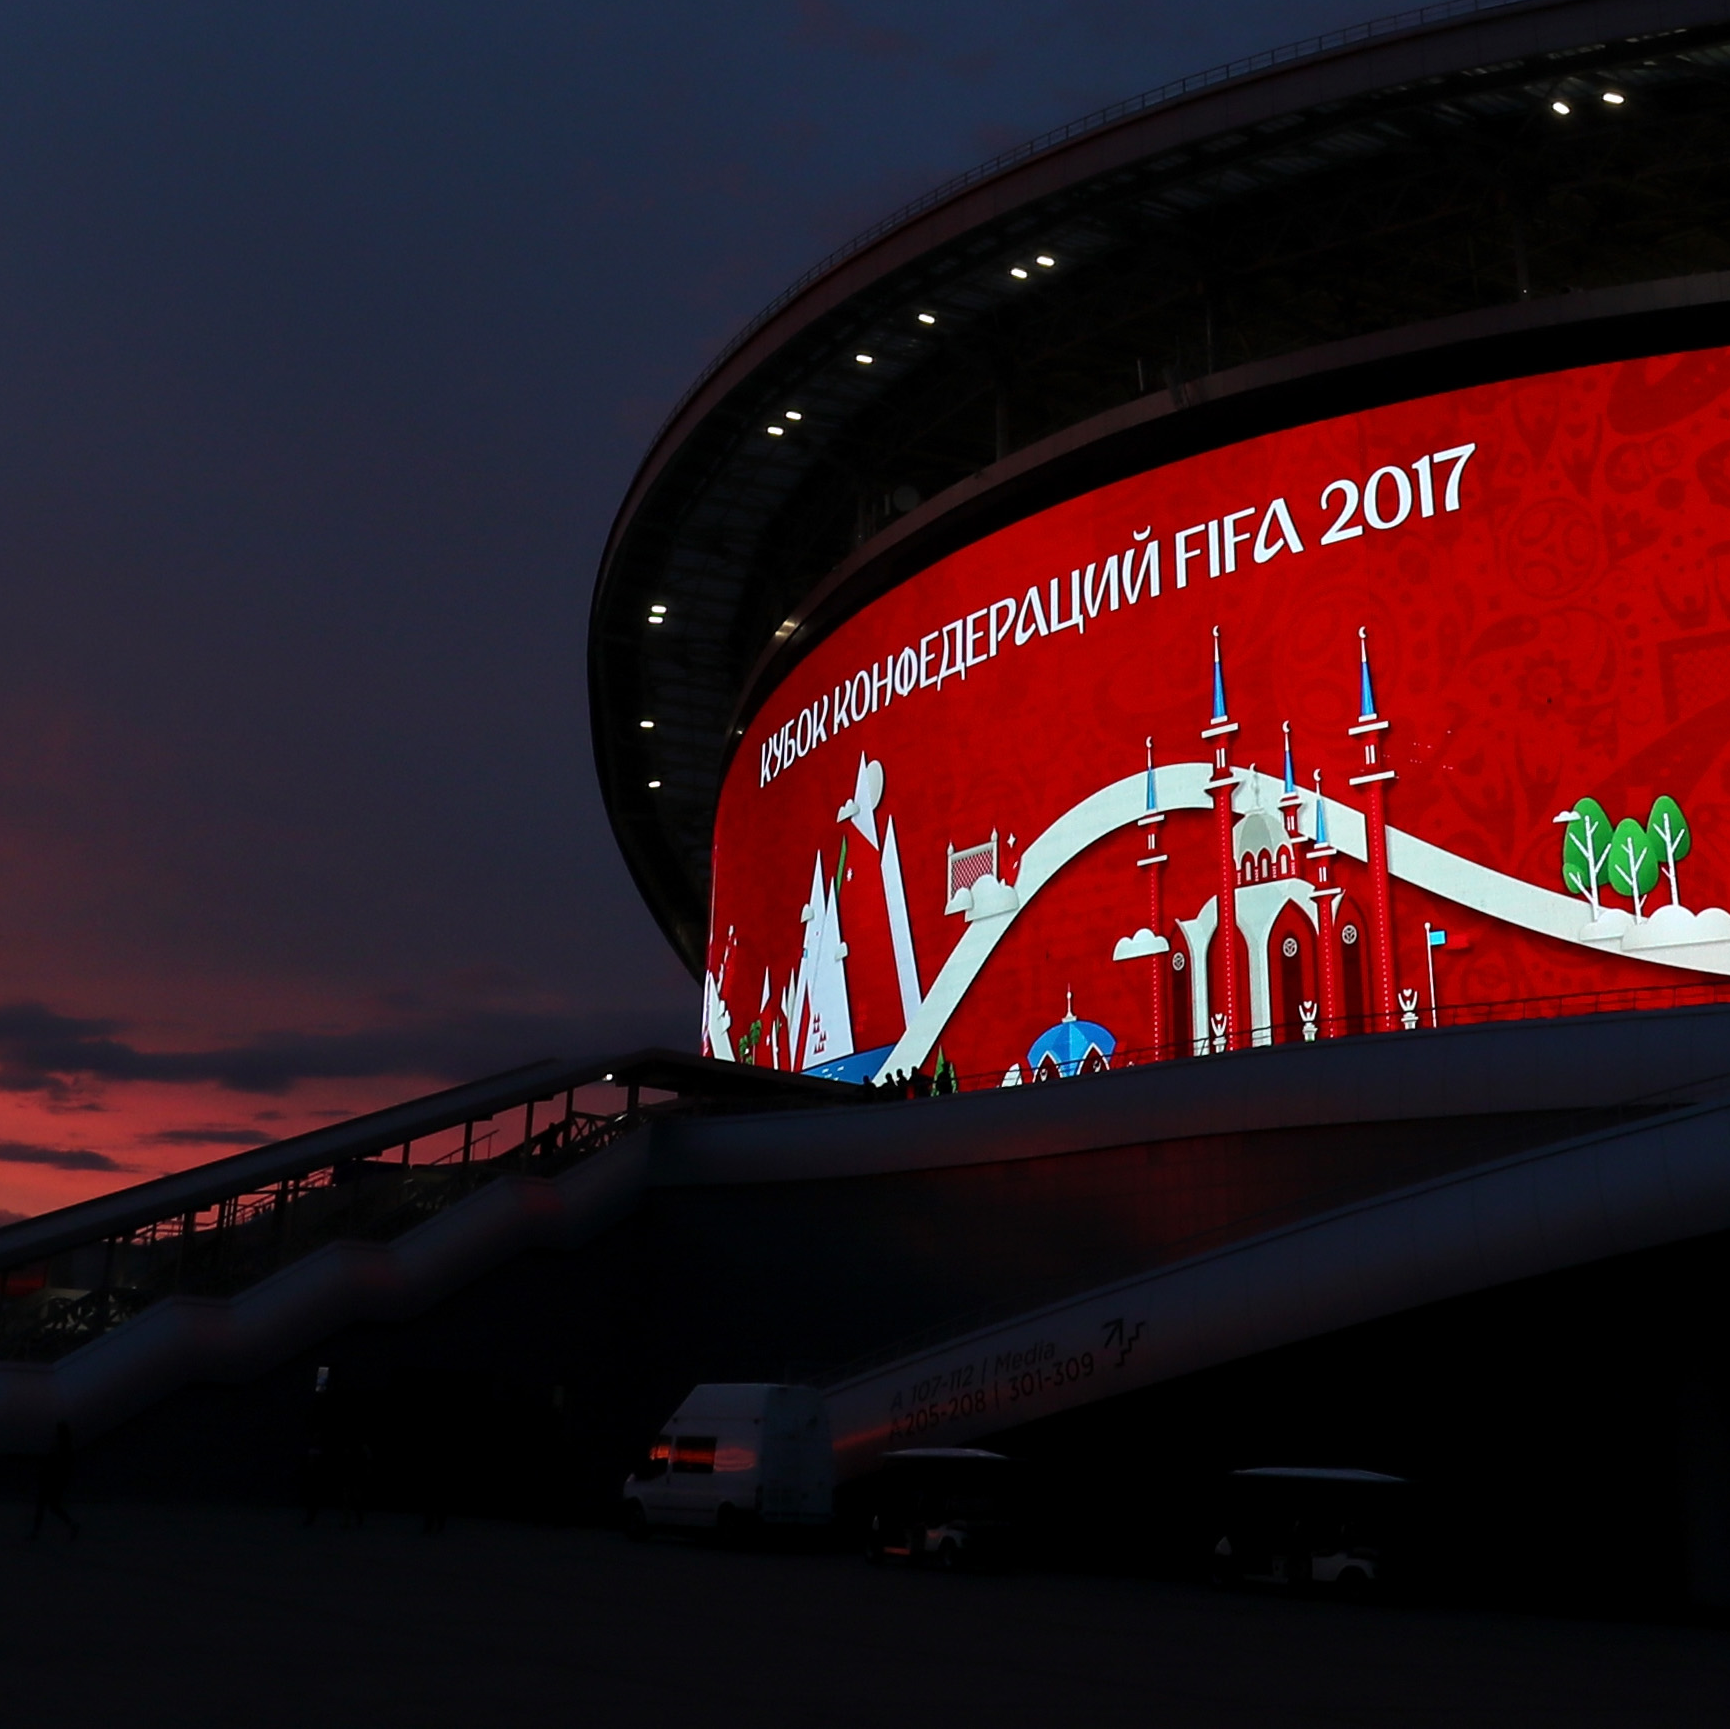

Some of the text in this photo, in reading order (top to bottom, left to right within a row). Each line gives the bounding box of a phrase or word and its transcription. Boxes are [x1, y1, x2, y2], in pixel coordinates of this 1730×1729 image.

[760, 442, 1476, 788] КУБОК КОНФЕДЕРАЦИЙ FIFA 2017
[912, 1364, 974, 1403] 107-112
[995, 1341, 1057, 1376] Media
[1009, 1352, 1095, 1402] 301-309
